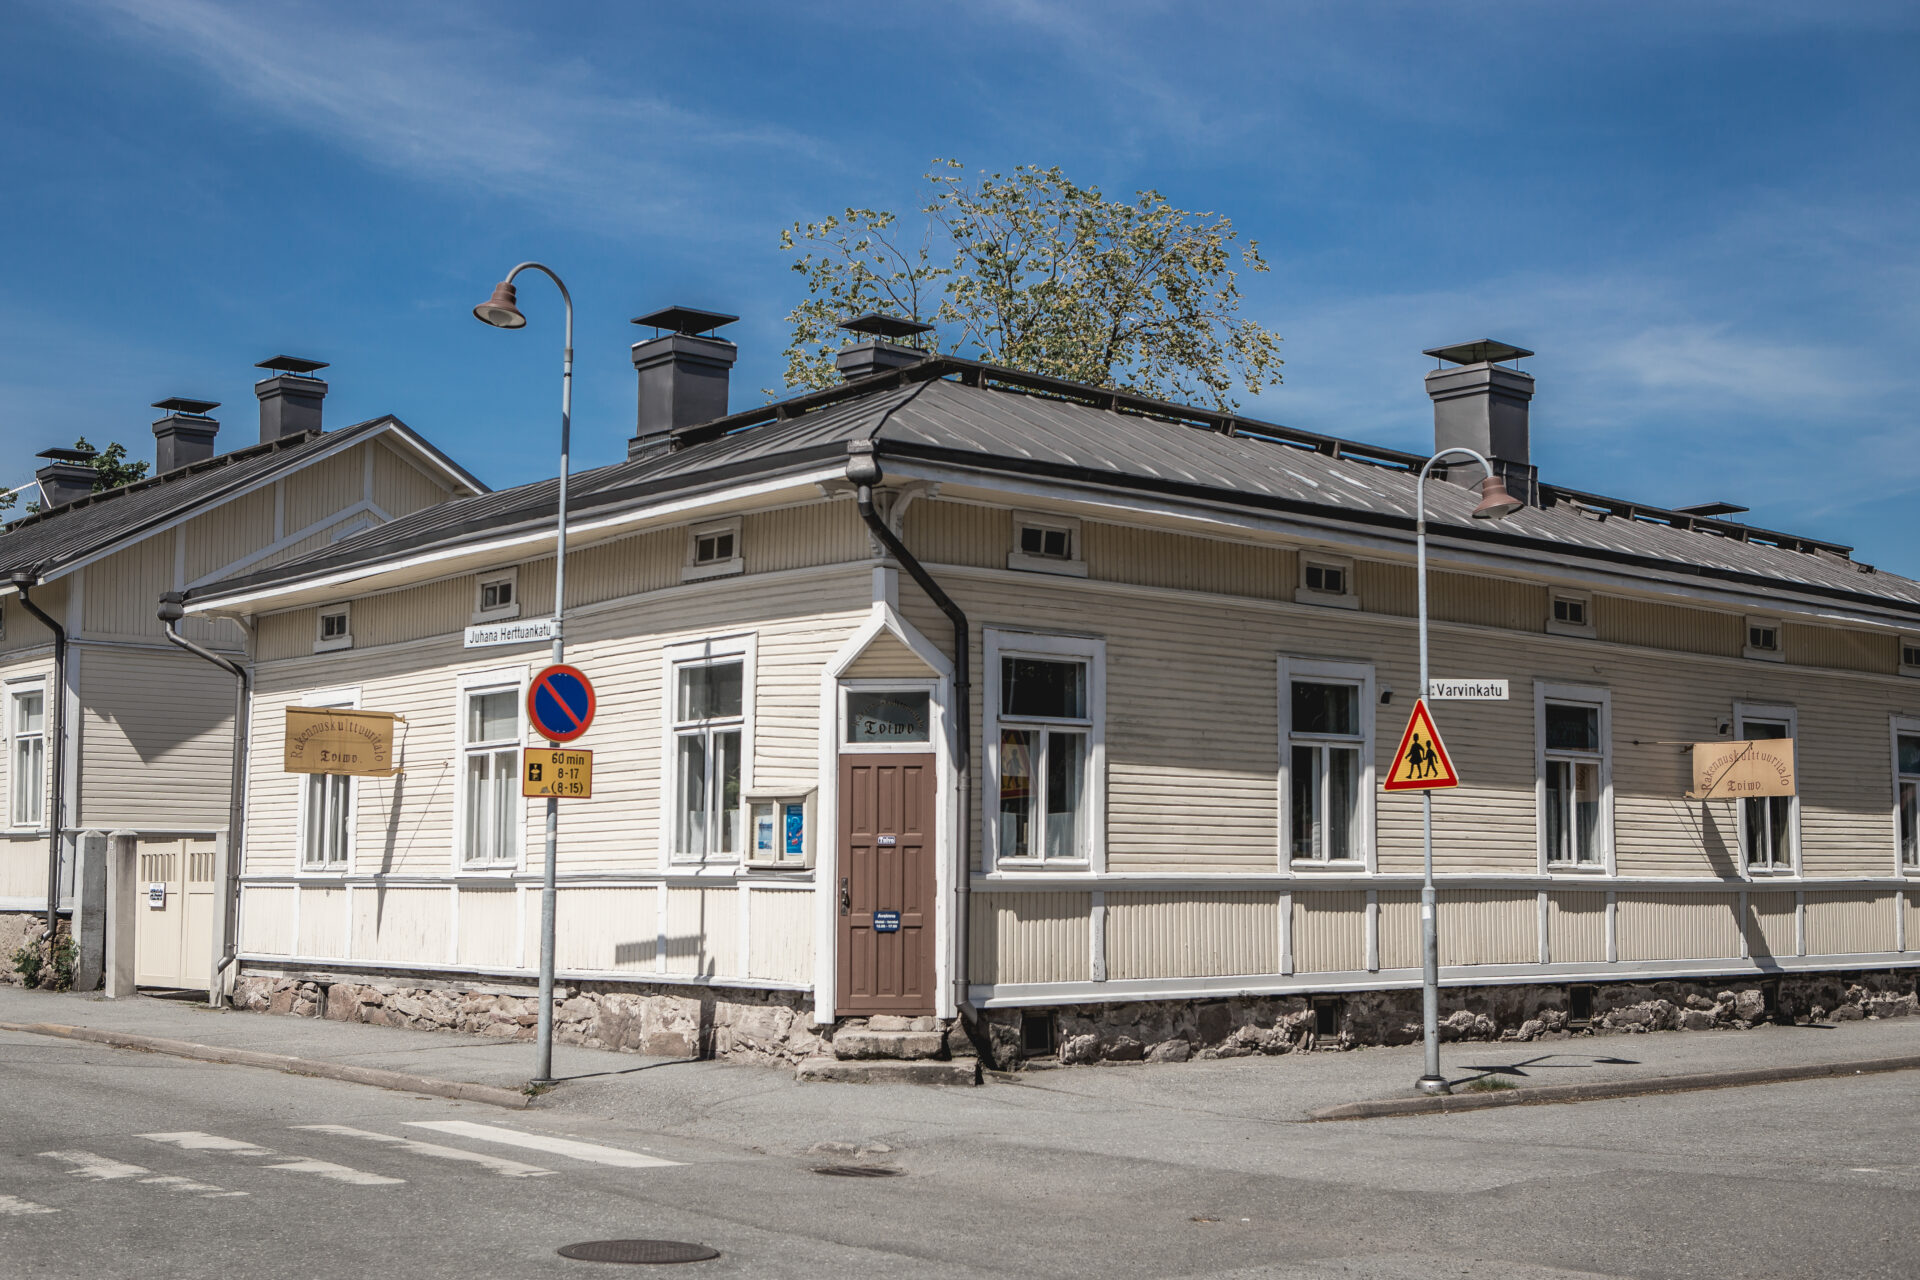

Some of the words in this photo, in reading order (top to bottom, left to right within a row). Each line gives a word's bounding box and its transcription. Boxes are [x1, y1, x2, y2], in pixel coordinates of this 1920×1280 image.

[470, 630, 498, 643] Juhana
[500, 623, 551, 641] Herttuankatu
[1436, 683, 1502, 697] Varvinkatu
[864, 720, 914, 735] Toiwo
[551, 752, 564, 764] 60
[566, 754, 585, 765] min
[1701, 749, 1791, 791] Rakennuskulttuuritalo
